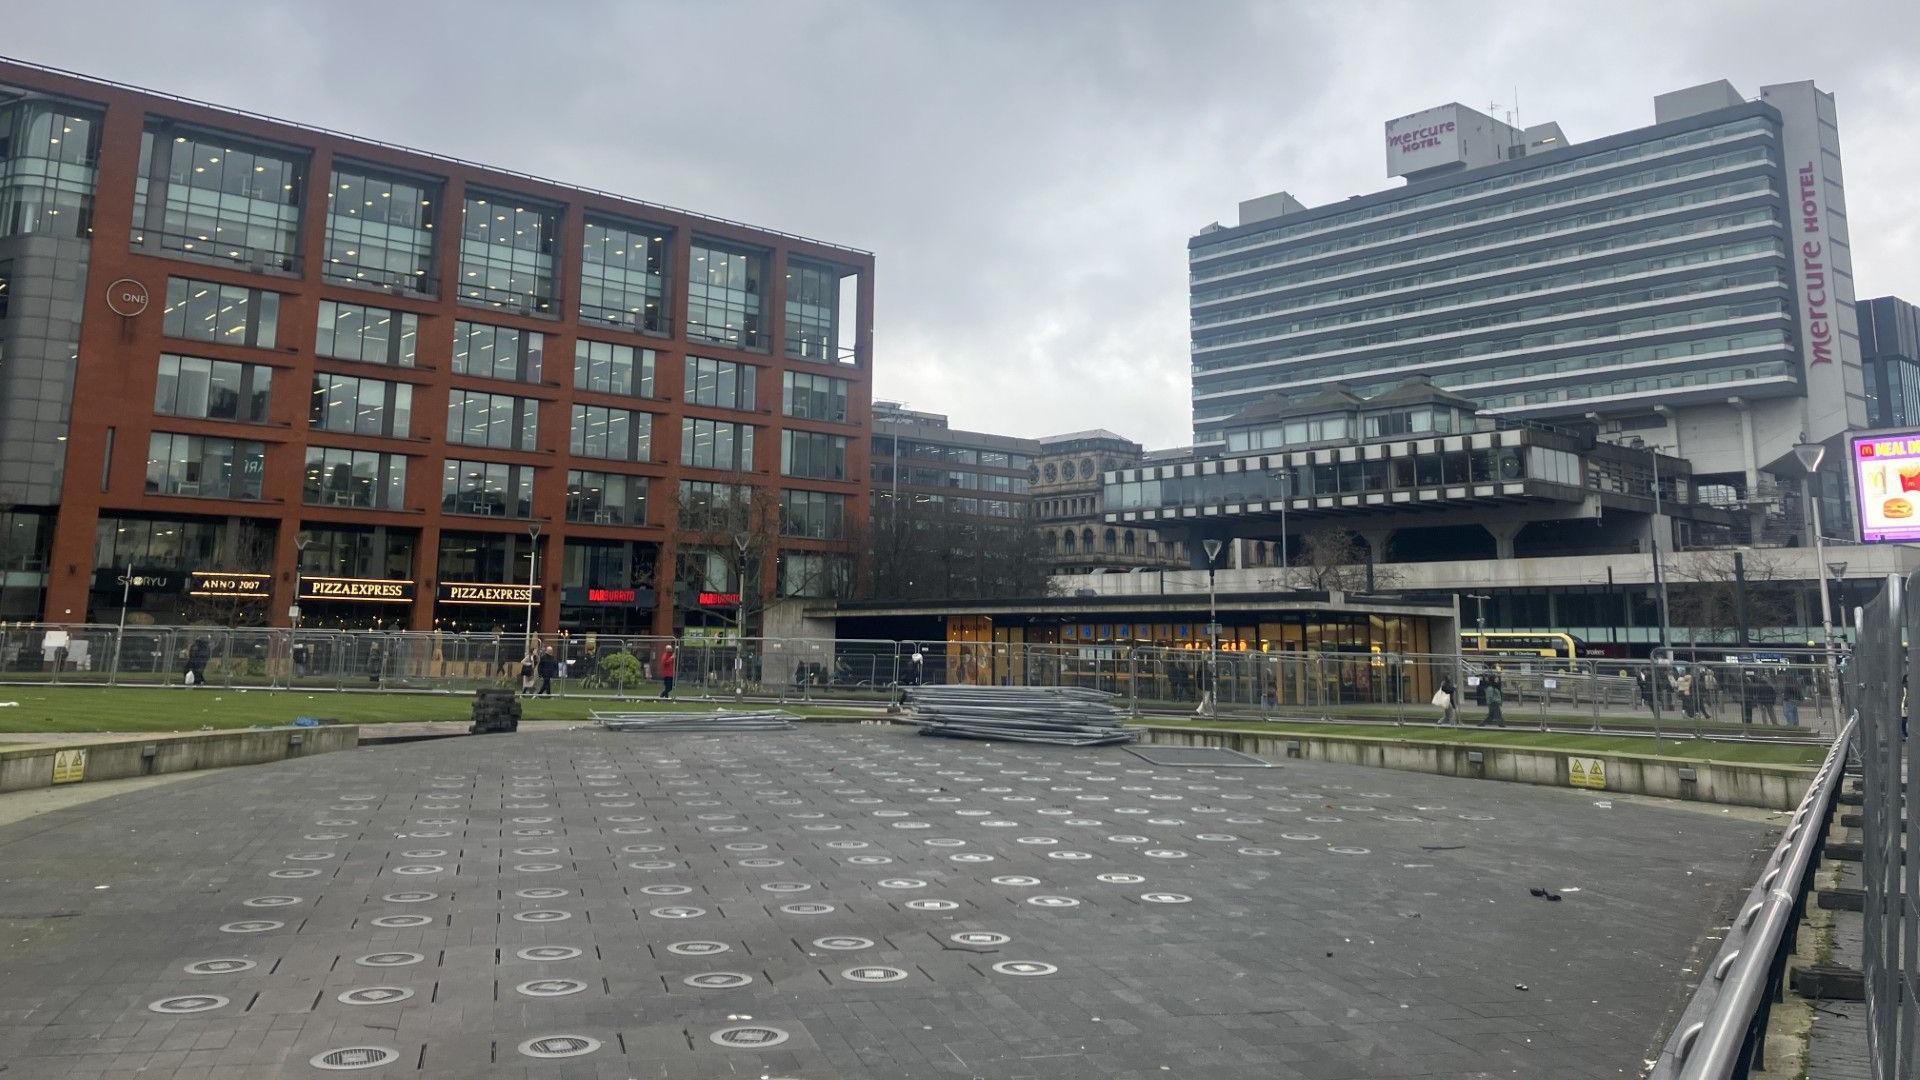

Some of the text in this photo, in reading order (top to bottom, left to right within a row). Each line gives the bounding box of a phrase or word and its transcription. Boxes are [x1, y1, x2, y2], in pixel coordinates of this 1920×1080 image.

[1388, 121, 1455, 147] mercure
[1402, 137, 1441, 153] HOTEL
[1799, 160, 1833, 369] mercure HOTEL
[122, 293, 148, 304] ONE
[1875, 442, 1904, 456] MEAL
[117, 575, 167, 588] SHORYU
[203, 580, 260, 590] ANNO 2007
[312, 582, 402, 596] PIZZAEXPRESS
[450, 587, 532, 600] PIZZAEXPRESS
